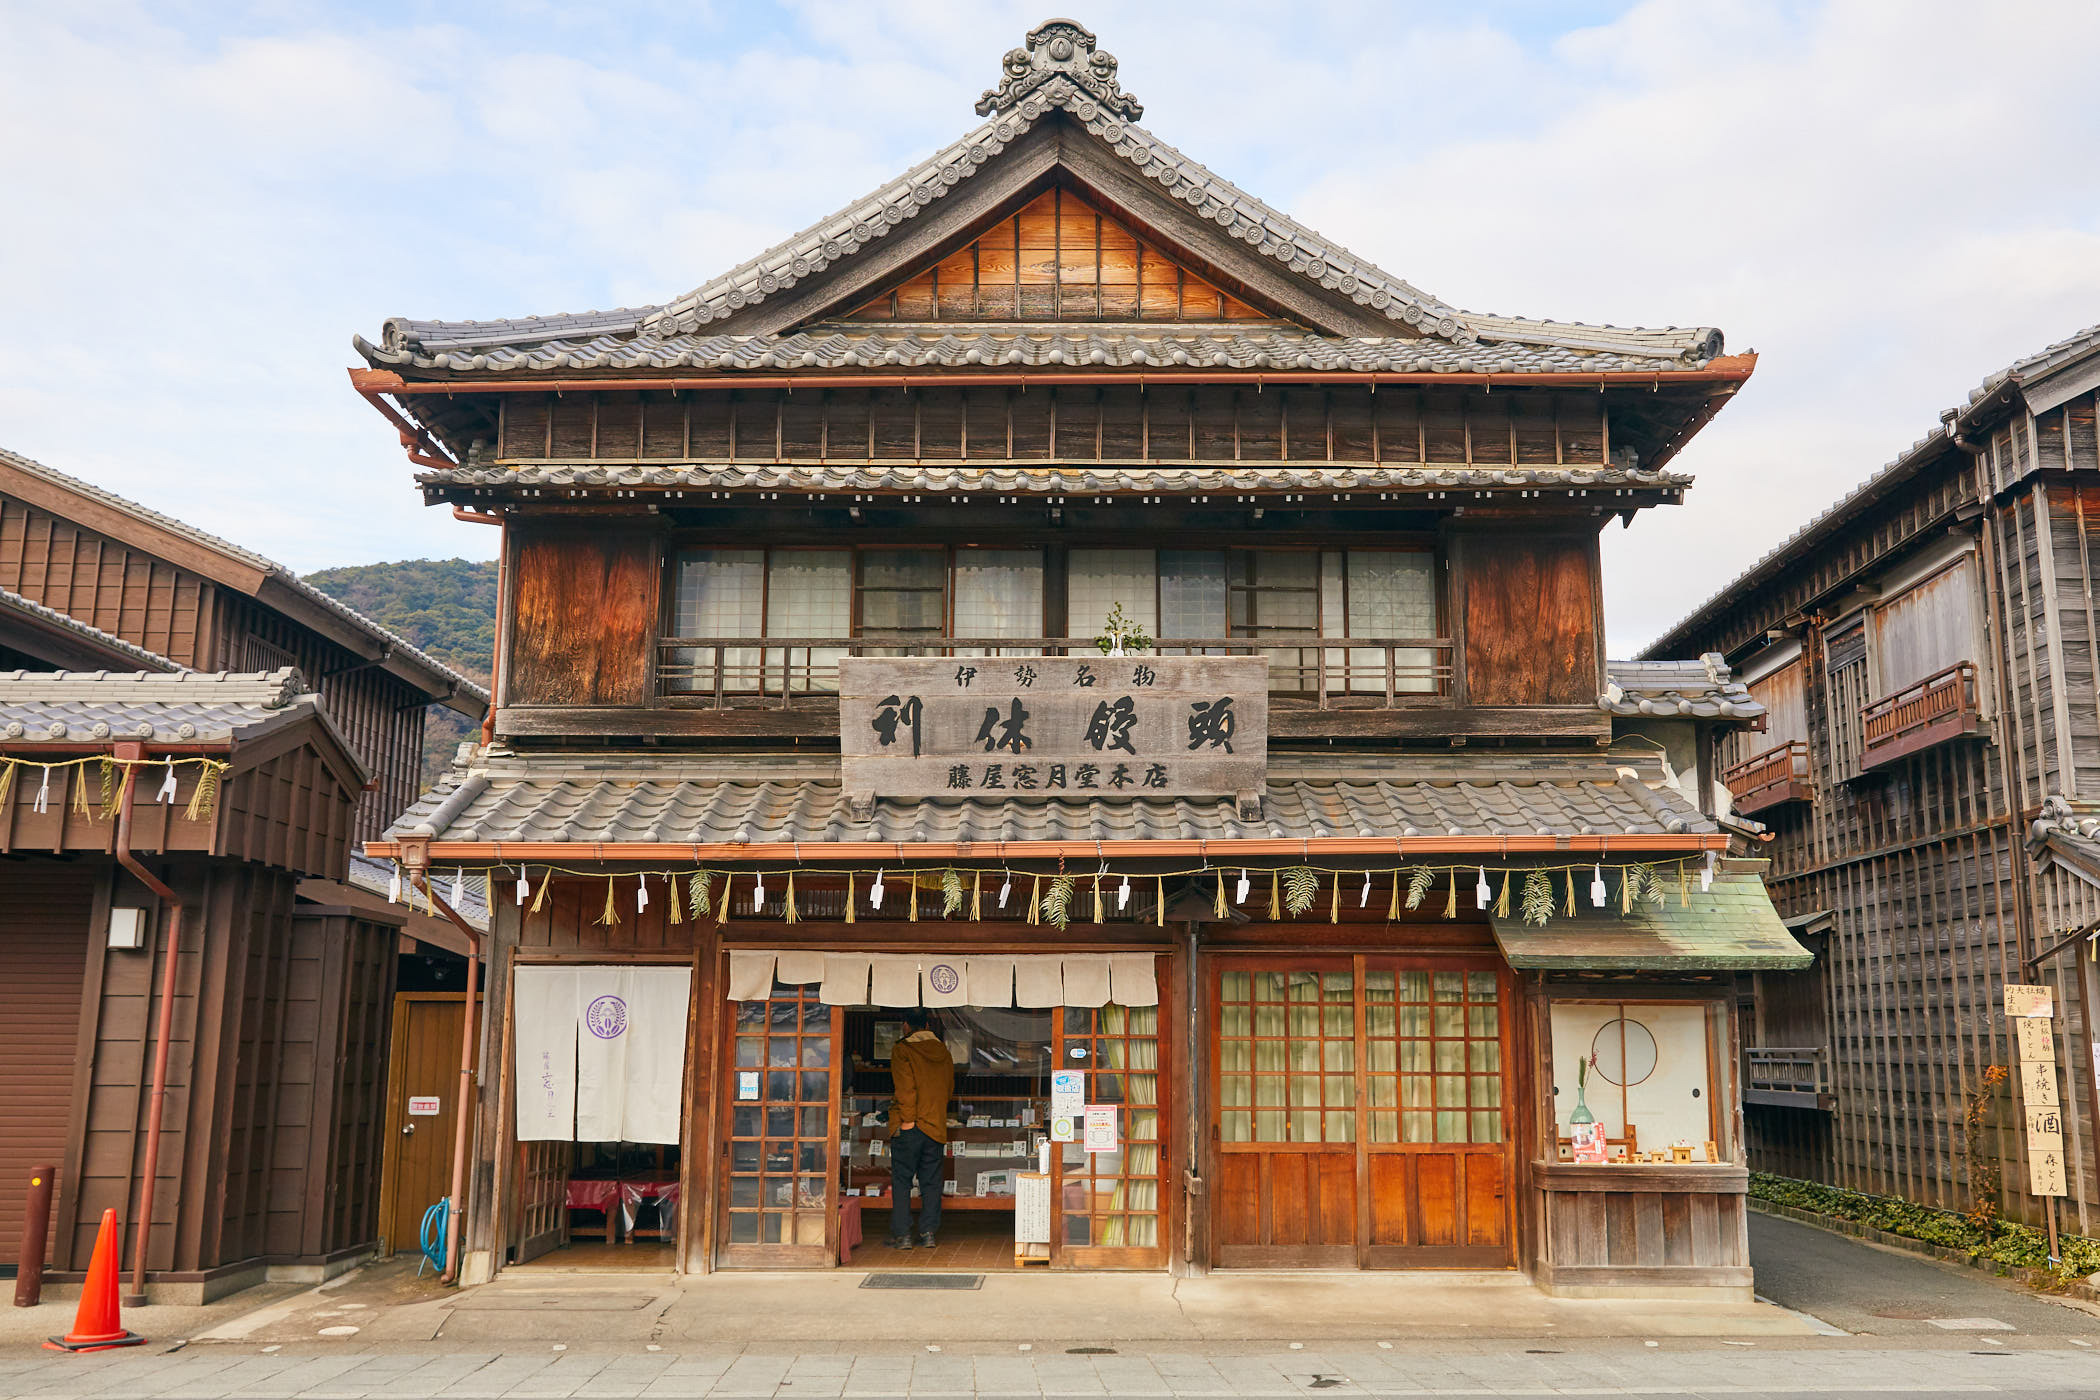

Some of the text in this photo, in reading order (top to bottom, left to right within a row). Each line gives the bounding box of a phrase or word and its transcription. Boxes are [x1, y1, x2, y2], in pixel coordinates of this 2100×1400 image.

[954, 664, 1156, 688] 伊勢名物
[872, 694, 1235, 759] 利休饅頭
[2036, 1063, 2051, 1105] 串焼き
[2035, 1112, 2060, 1135] 酒
